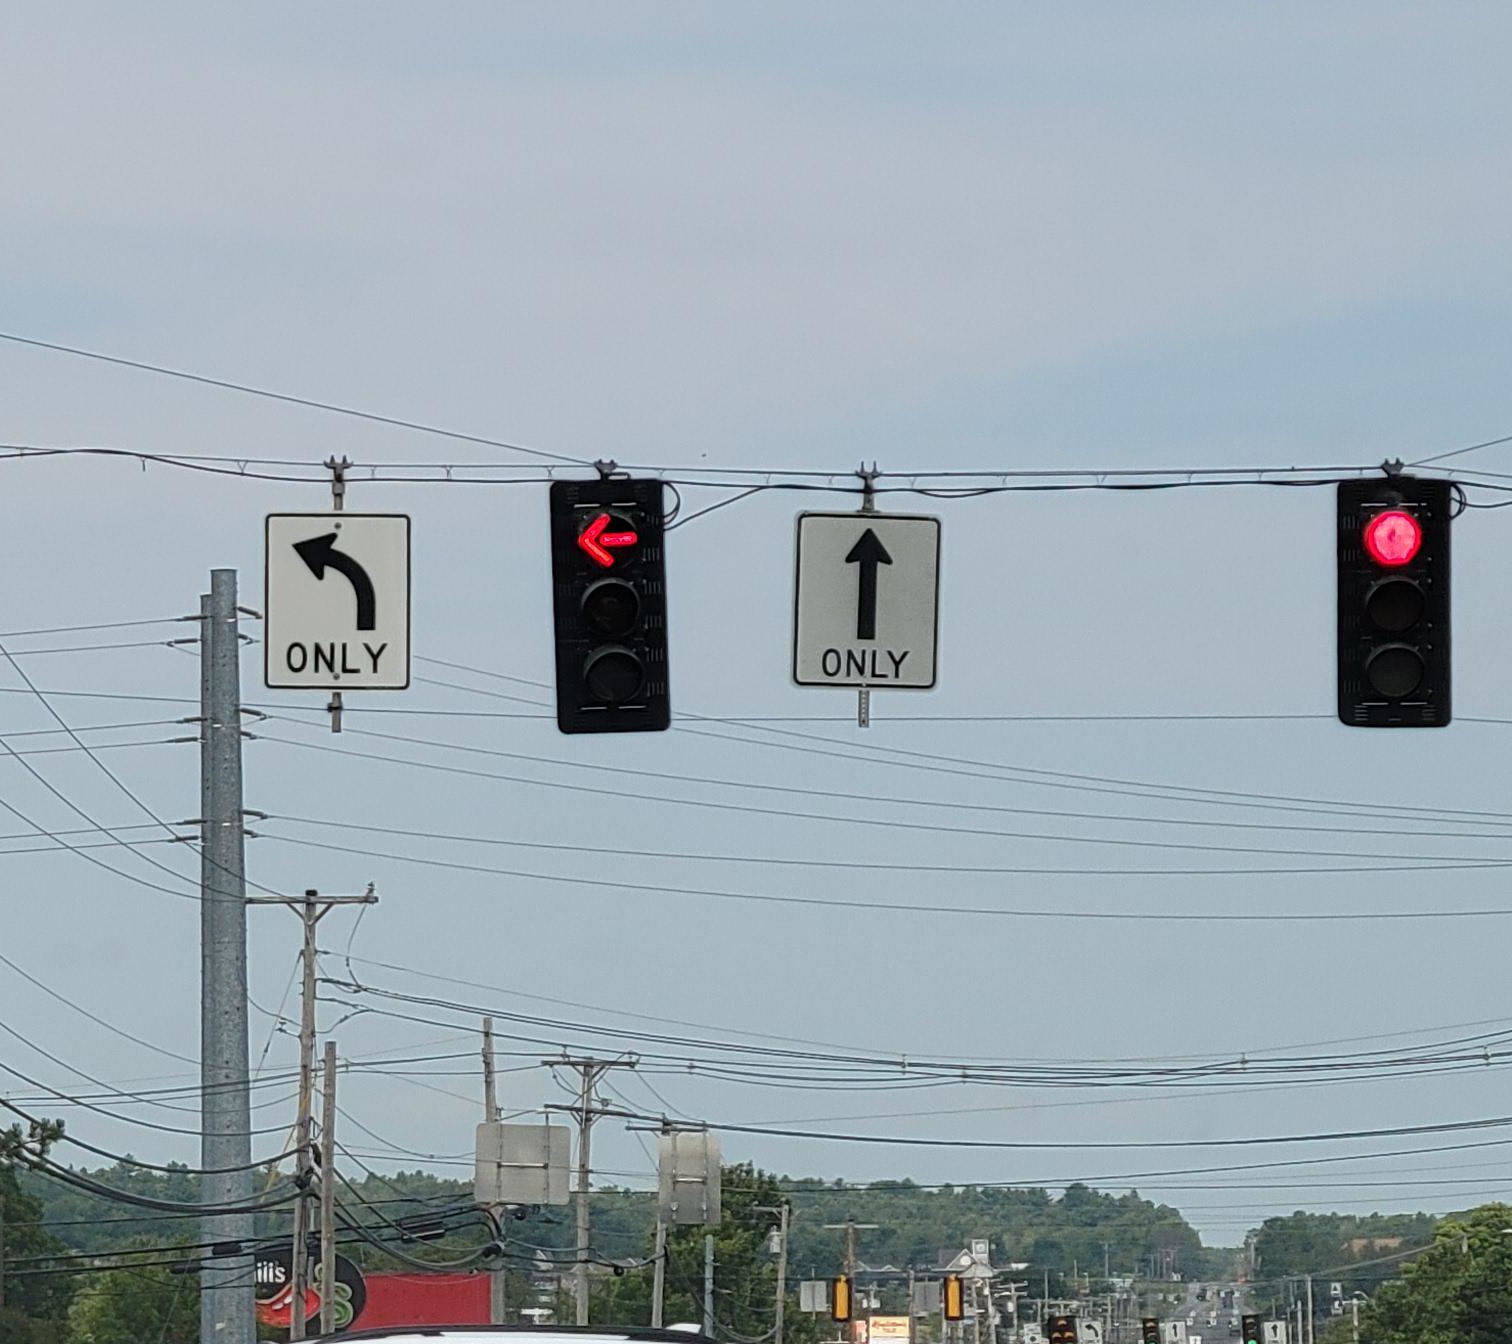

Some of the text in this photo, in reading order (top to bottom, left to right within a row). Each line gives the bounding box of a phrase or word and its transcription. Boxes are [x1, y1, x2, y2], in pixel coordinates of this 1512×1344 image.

[286, 642, 388, 674] ONLY
[822, 648, 911, 679] ONLY
[254, 1260, 286, 1283] ili's
